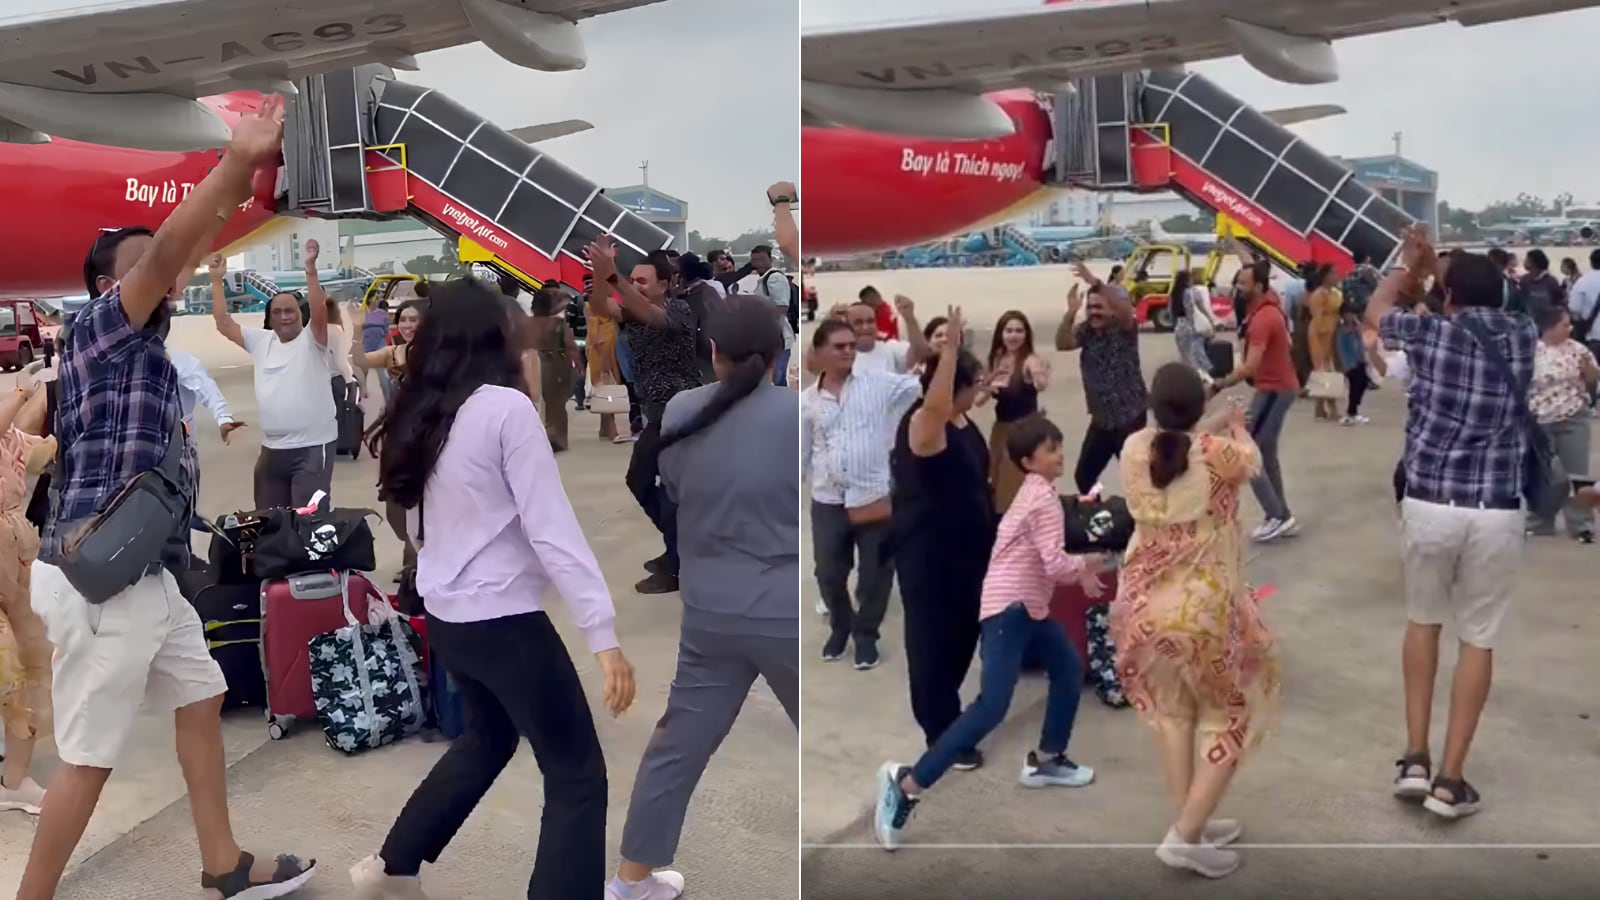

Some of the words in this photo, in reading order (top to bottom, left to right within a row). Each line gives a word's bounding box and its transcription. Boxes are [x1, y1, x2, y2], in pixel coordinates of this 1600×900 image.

[900, 148, 934, 176] Bay
[935, 150, 950, 173] là
[953, 152, 991, 176] Thích
[125, 177, 159, 208] Bay
[161, 179, 177, 203] là
